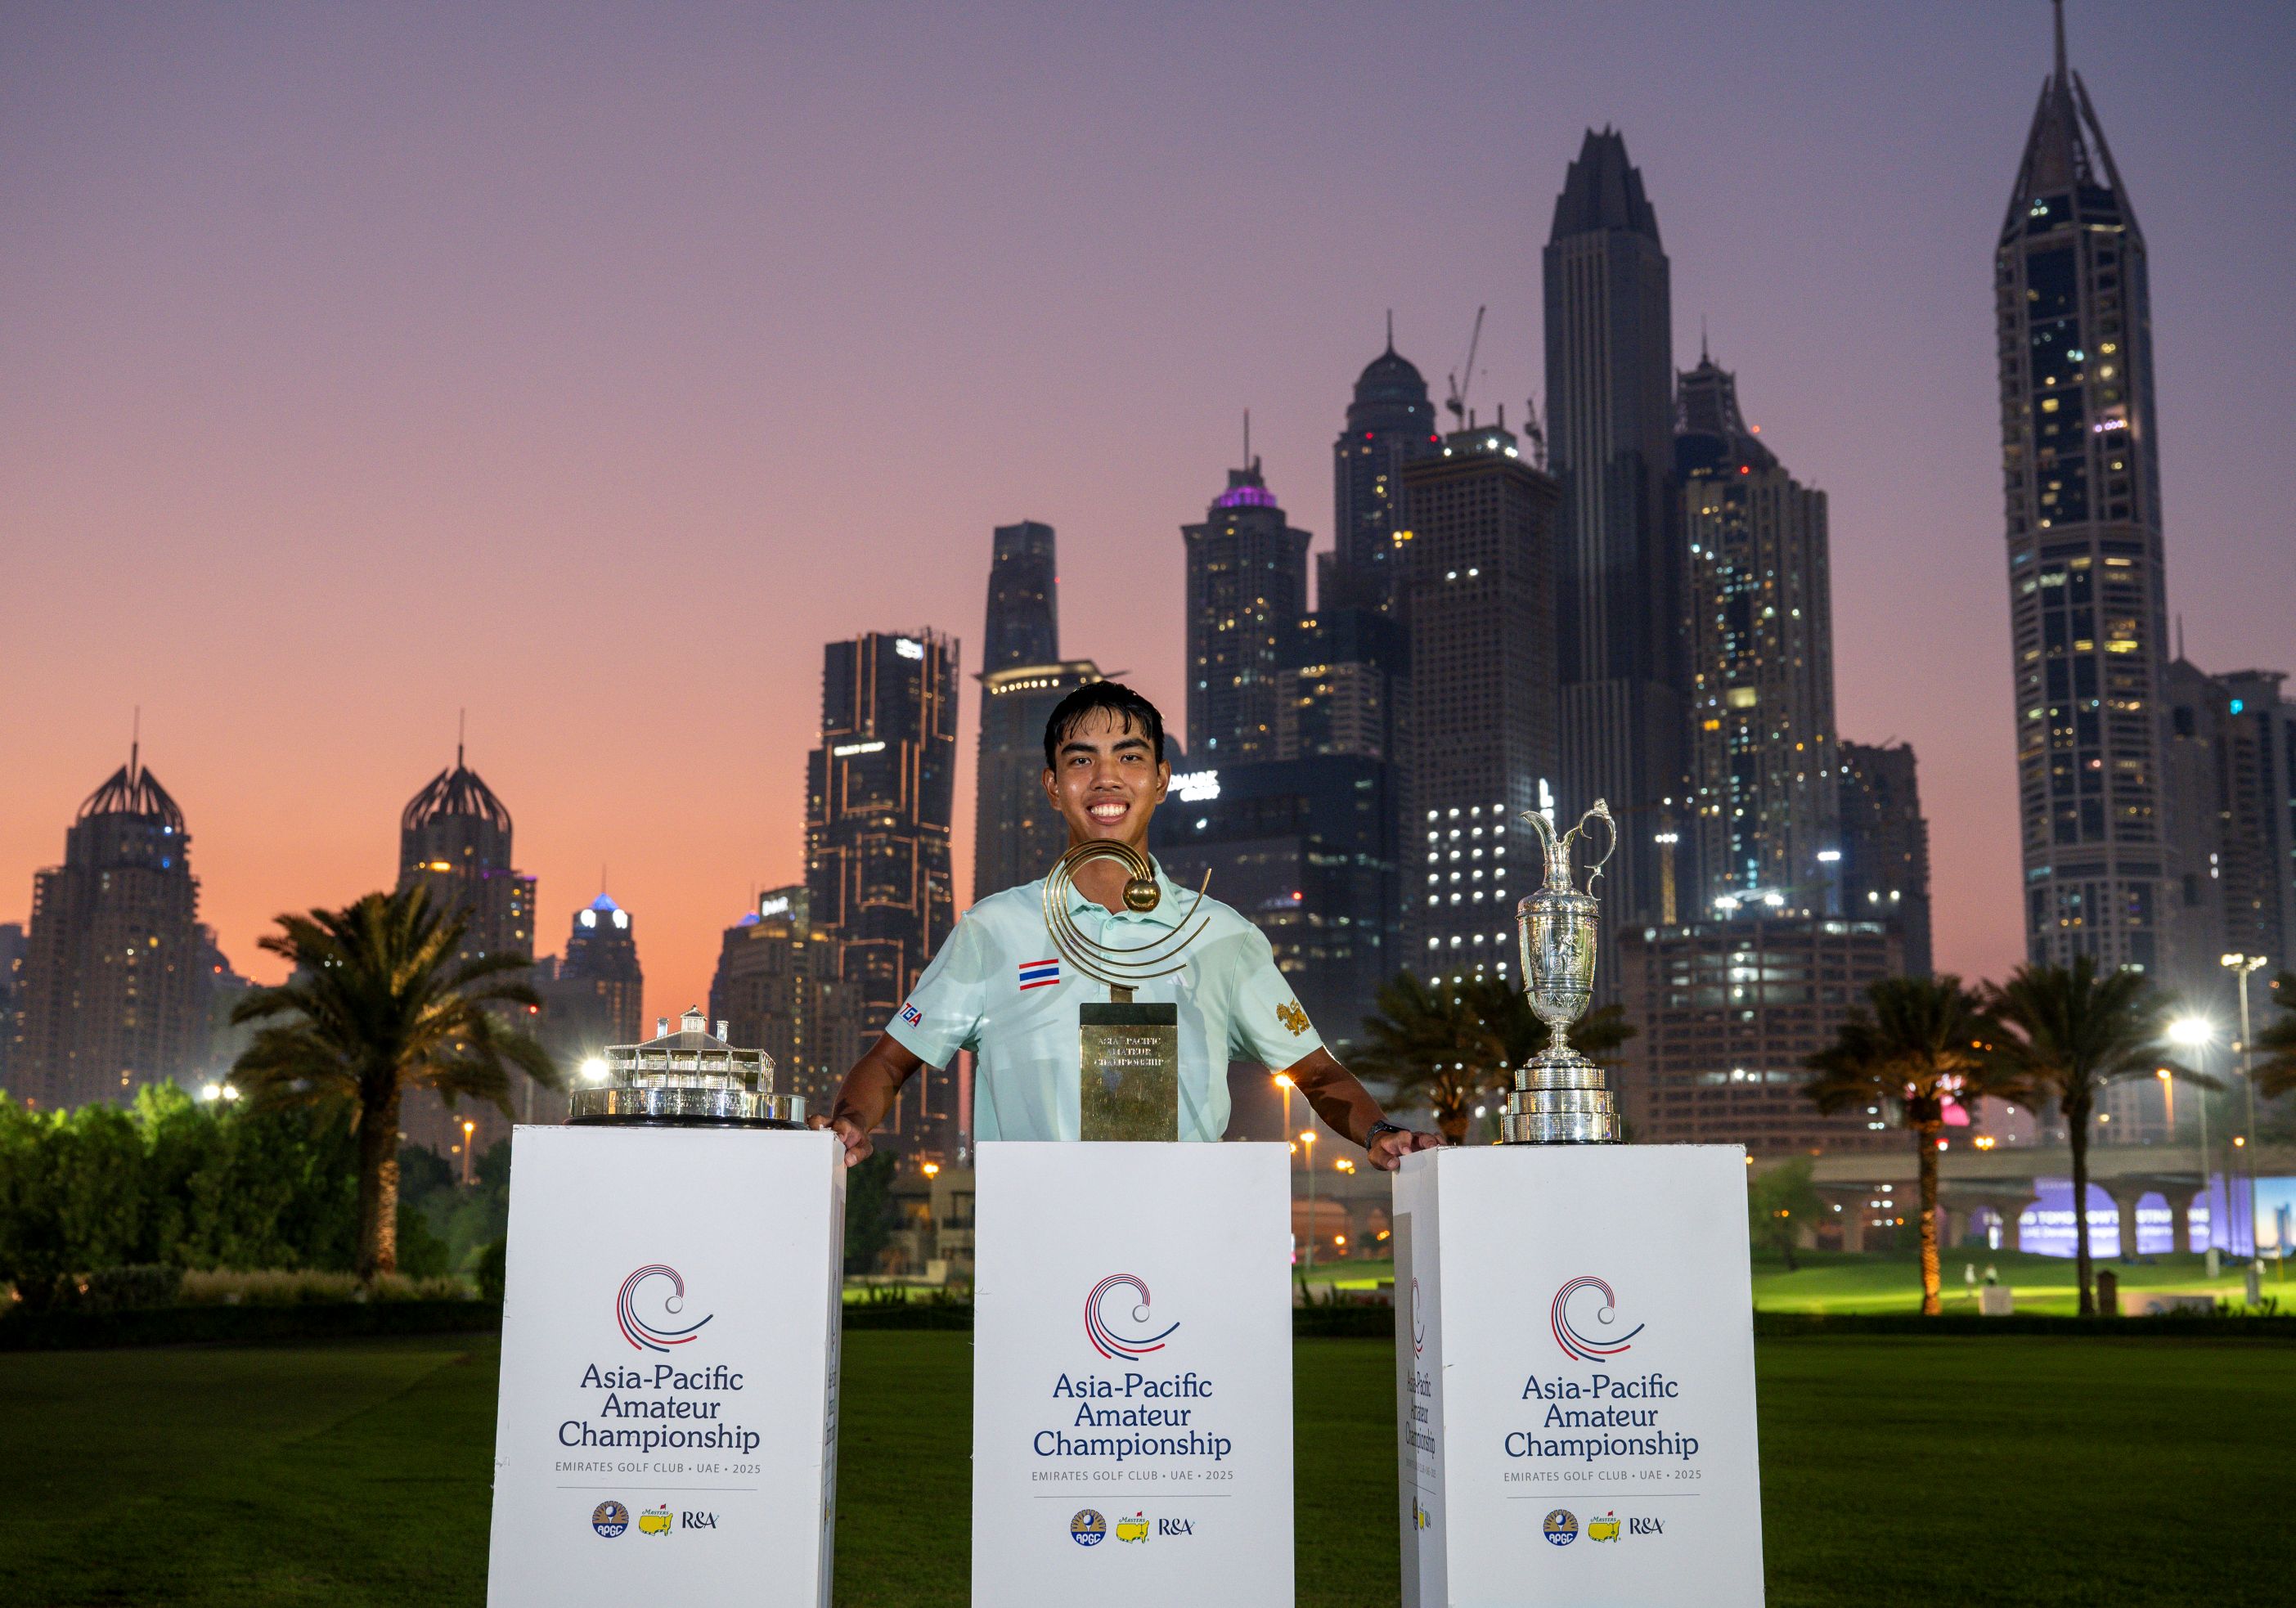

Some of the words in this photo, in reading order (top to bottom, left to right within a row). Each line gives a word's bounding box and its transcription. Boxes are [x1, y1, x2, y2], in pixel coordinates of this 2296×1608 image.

[899, 1002, 923, 1027] TGA
[580, 1363, 743, 1390] Asia-Pacific
[1053, 1372, 1212, 1398] Asia-Pacific
[1522, 1373, 1678, 1399] Asia-Pacific
[600, 1393, 721, 1419] Amateur
[1074, 1402, 1191, 1426] Amateur
[1544, 1404, 1658, 1427] Amateur
[559, 1421, 760, 1454] Championship
[1034, 1430, 1231, 1462] Championship
[1505, 1431, 1698, 1462] Championship
[555, 1461, 613, 1472] EMIRATES
[618, 1462, 649, 1472] GOLF
[653, 1462, 684, 1473] CLUB
[697, 1463, 720, 1473] UAE
[732, 1464, 761, 1474] 2025
[1031, 1471, 1089, 1481] EMIRATES
[1093, 1471, 1124, 1481] GOLF
[1128, 1470, 1158, 1480] CLUB
[1170, 1470, 1193, 1480] UAE
[1206, 1470, 1233, 1480] 2025
[1503, 1471, 1560, 1482] EMIRATES
[1563, 1471, 1594, 1481] GOLF
[1597, 1471, 1628, 1480] CLUB
[1639, 1470, 1662, 1480] UAE
[1674, 1469, 1701, 1480] 2025
[597, 1525, 623, 1537] APGC
[681, 1511, 718, 1529] R&A
[1158, 1518, 1194, 1536] R&A
[1629, 1517, 1665, 1535] R&A
[1076, 1533, 1102, 1545] APGC
[1548, 1533, 1574, 1544] APGC
